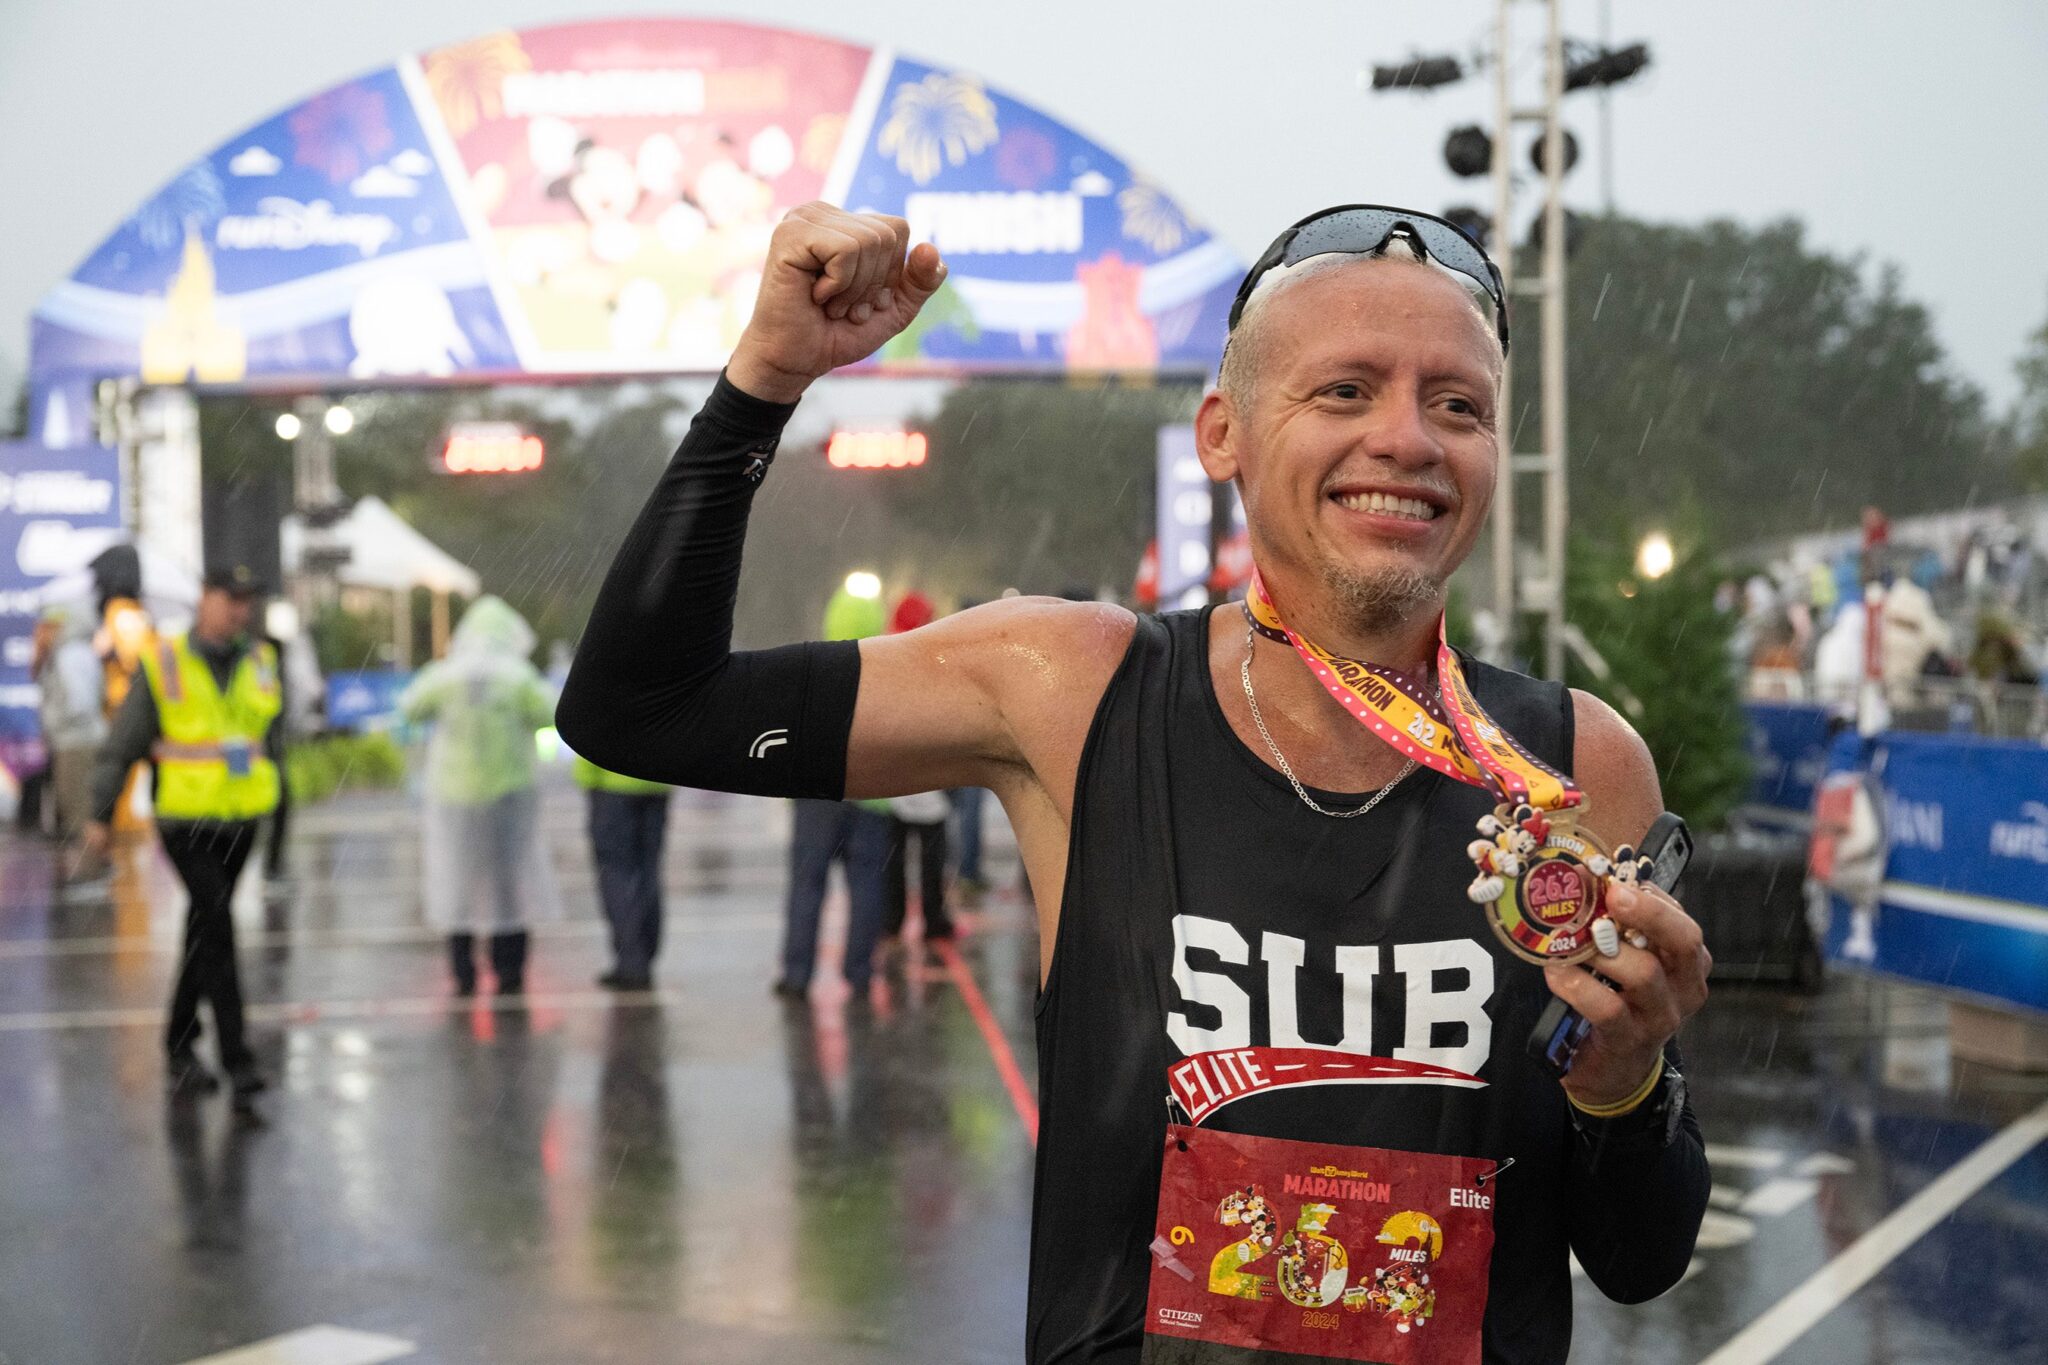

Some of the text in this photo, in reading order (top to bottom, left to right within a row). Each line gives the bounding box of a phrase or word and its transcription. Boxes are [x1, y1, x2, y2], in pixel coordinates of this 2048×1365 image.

[1529, 871, 1582, 906] 26.2
[1541, 901, 1577, 919] MILES
[1548, 936, 1577, 953] 2024
[1166, 913, 1495, 1077] SUB
[1173, 1050, 1272, 1120] ELITE
[1283, 1174, 1391, 1203] MARATHON
[1450, 1187, 1491, 1210] Elite
[1389, 1248, 1428, 1263] MILES
[1159, 1307, 1203, 1323] CITIZEN
[1301, 1310, 1340, 1330] 2024
